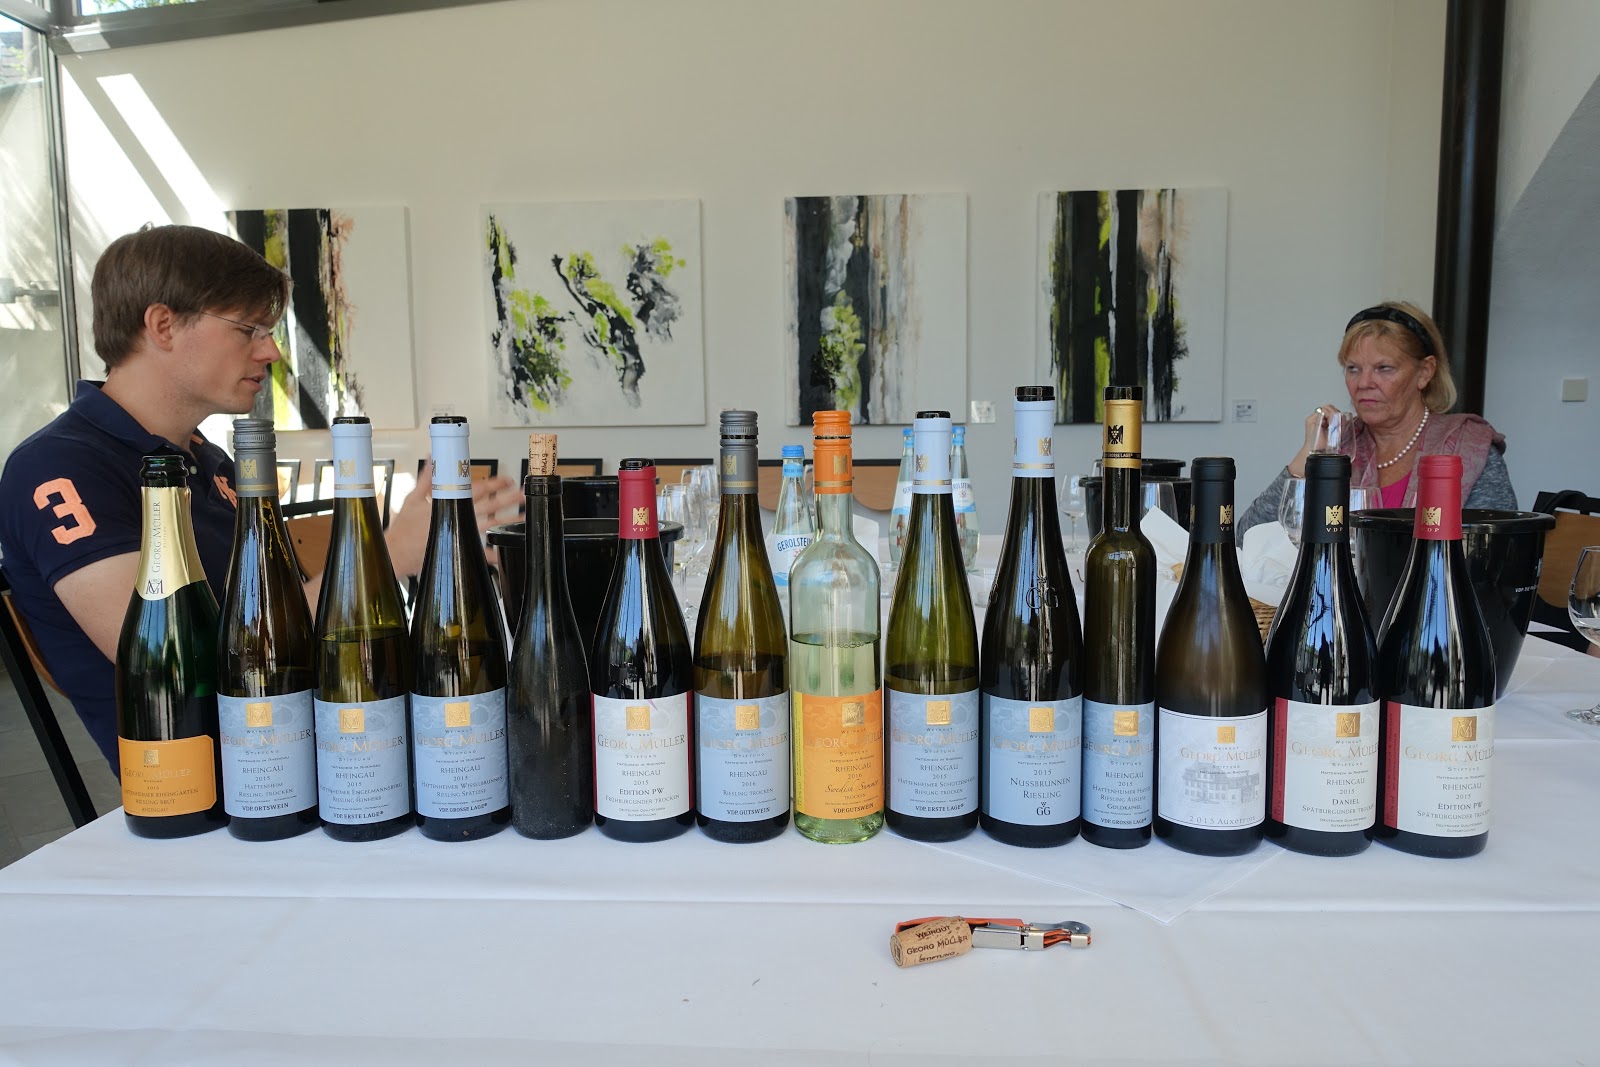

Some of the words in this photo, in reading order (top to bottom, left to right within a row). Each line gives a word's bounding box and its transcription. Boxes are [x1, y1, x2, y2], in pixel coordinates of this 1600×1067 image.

[33, 477, 97, 546] 3
[152, 501, 161, 539] MÜLLER
[151, 540, 161, 573] GEORG
[640, 734, 685, 750] MÜLLER
[1227, 749, 1262, 761] MÜLLER
[243, 765, 284, 773] RHEINGAU
[440, 765, 480, 773] RHEINGAU
[836, 762, 872, 772] RHEINGAU
[1010, 777, 1071, 787] NUSSBRUNNEN
[266, 788, 293, 796] TROCKEN
[1023, 790, 1061, 798] RIESLING
[1093, 785, 1135, 795] HATTENHEIMER
[655, 794, 679, 803] TROCKEN
[1100, 794, 1126, 802] RIESLING
[1036, 807, 1051, 816] GG
[1190, 816, 1214, 824] 2015
[916, 925, 951, 939] WEINGUT
[907, 943, 935, 955] GEORG
[937, 936, 968, 948] MÜLLER
